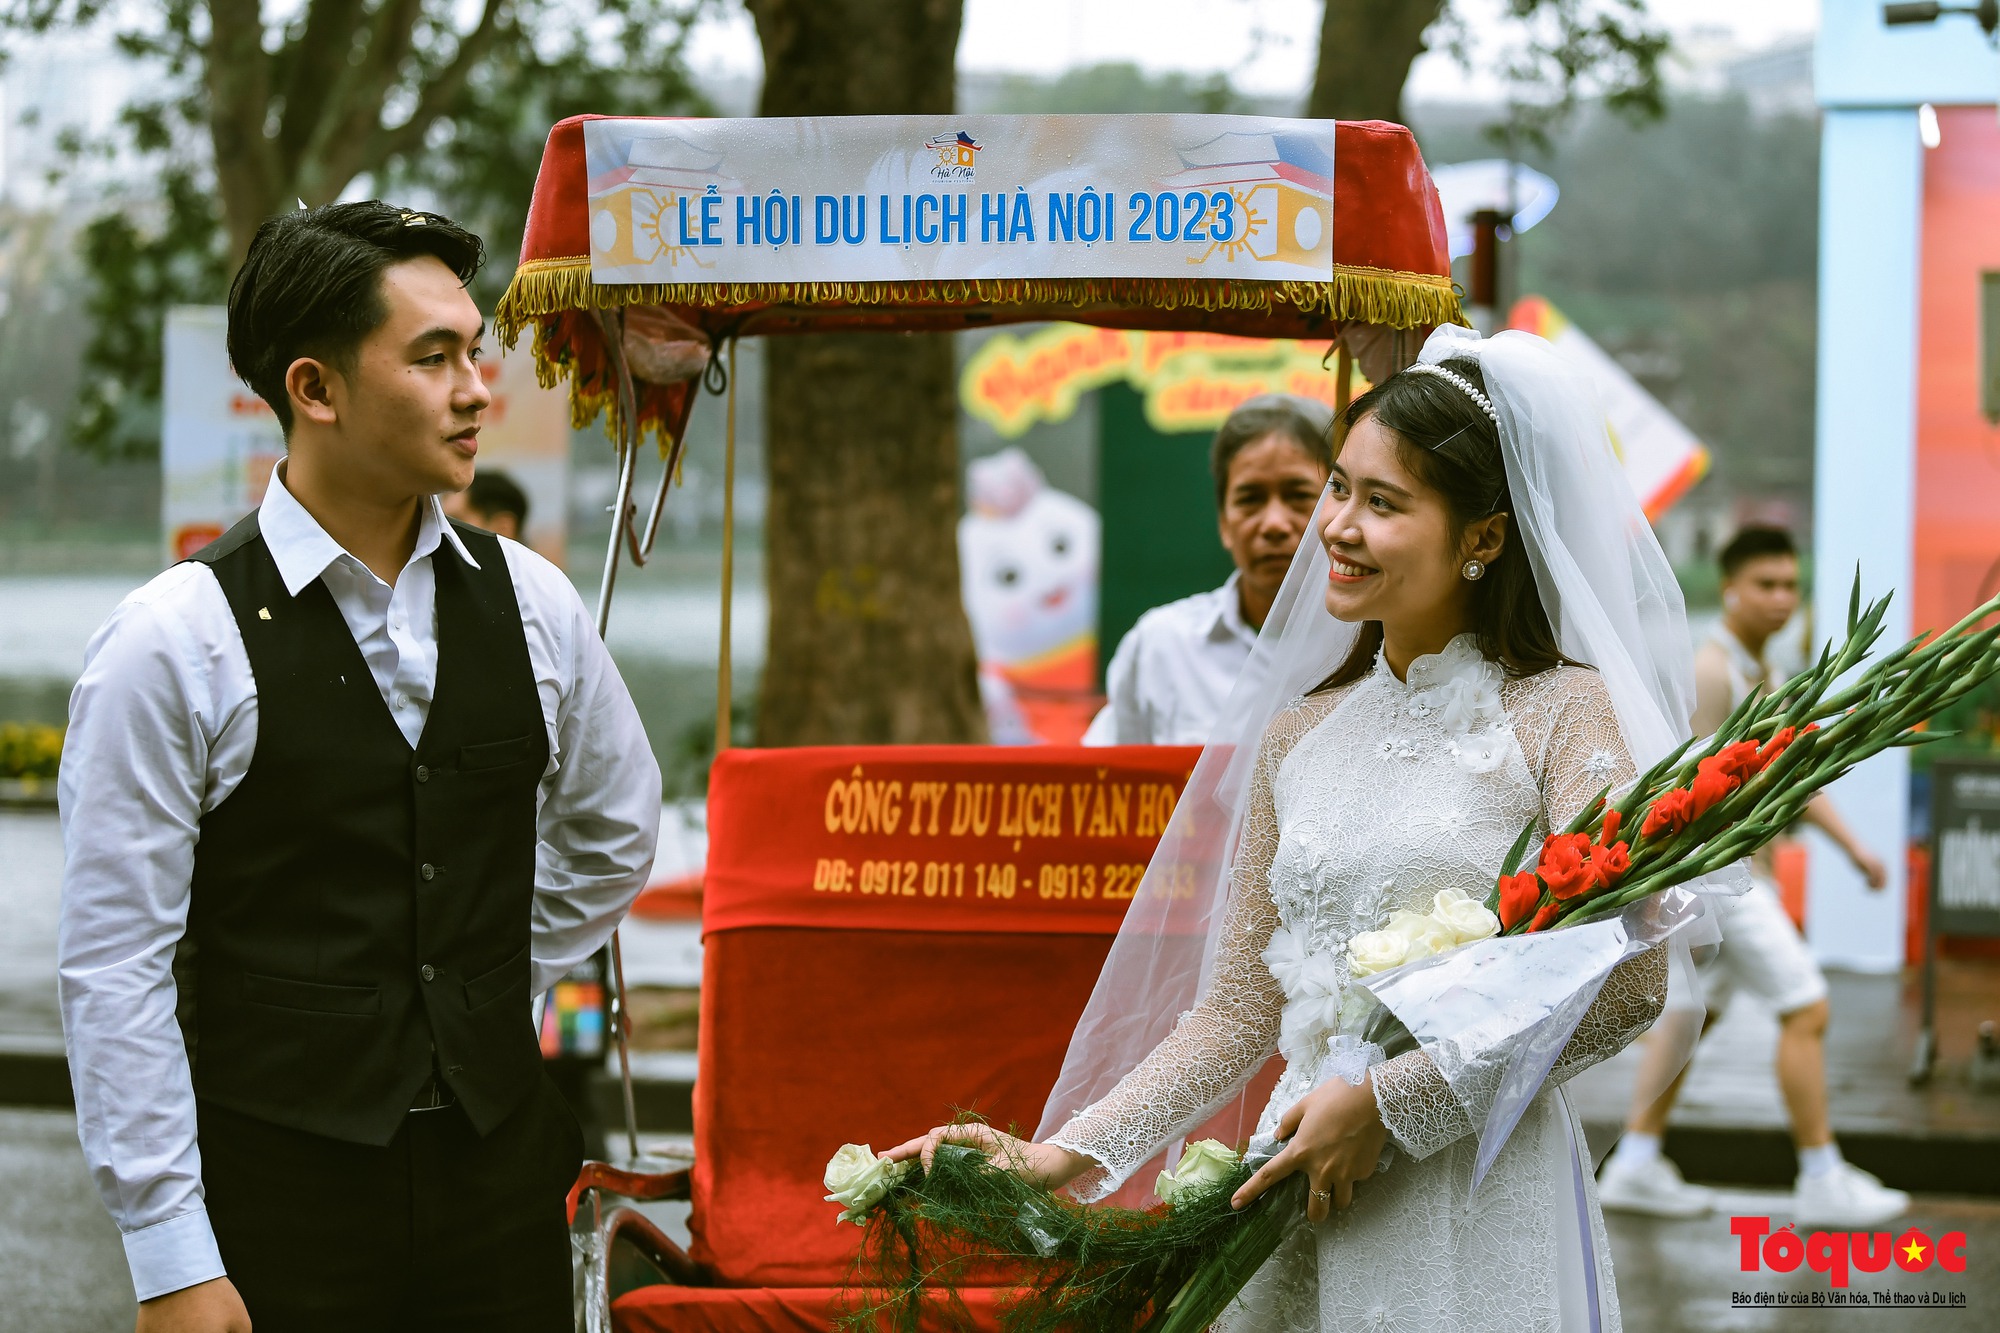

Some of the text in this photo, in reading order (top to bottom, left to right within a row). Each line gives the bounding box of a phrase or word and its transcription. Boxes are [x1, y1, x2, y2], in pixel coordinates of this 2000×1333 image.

[930, 166, 975, 180] Hà Nội
[679, 184, 1235, 251] LỄ HỘI DU LỊCH HÀ NỘI 2023
[825, 764, 903, 835] CÔNG
[909, 781, 948, 836] TY
[950, 782, 995, 837] DU
[998, 783, 1064, 853] LỊCH
[1071, 768, 1132, 837] VĂN
[859, 860, 918, 896] 0912
[923, 861, 965, 897] 011
[974, 863, 1017, 898] 140
[1038, 863, 1096, 899] 0913
